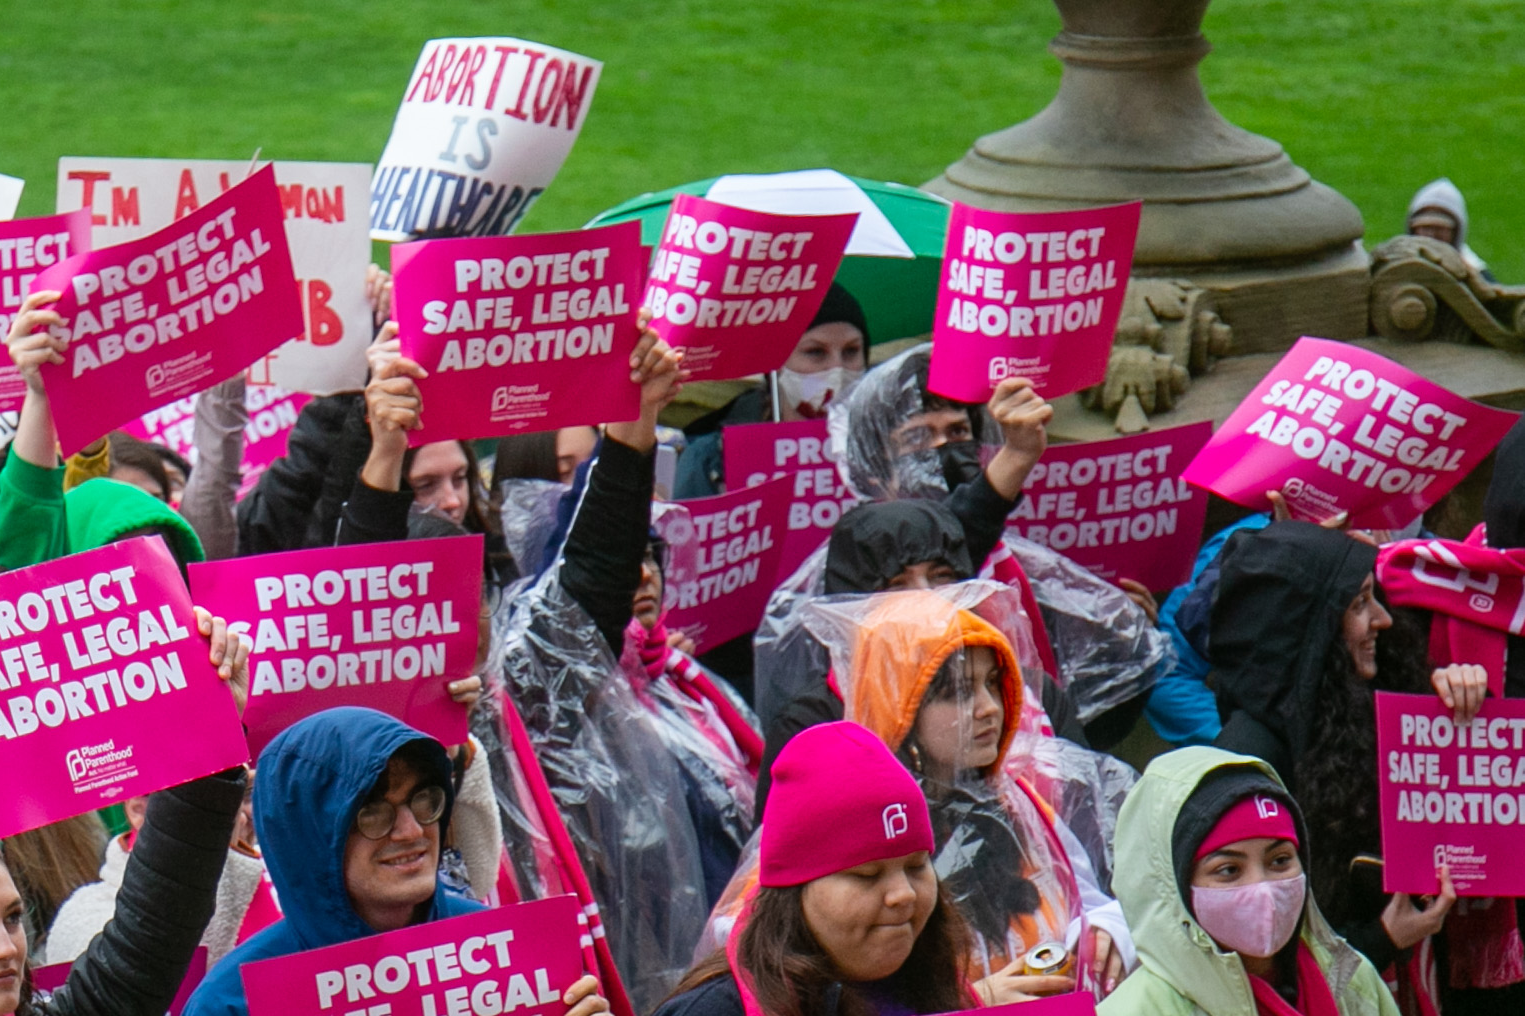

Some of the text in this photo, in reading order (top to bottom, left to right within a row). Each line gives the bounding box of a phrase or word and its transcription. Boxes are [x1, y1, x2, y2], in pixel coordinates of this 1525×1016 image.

[407, 44, 593, 131] ABORTION
[439, 115, 498, 171] IS
[174, 168, 199, 222] A
[72, 206, 236, 306] PROTECT
[665, 213, 814, 261] PROTECT
[961, 225, 1107, 265] PROTECT
[48, 290, 160, 344] SAFE,
[167, 227, 272, 307] LEGAL
[454, 247, 610, 293] PROTECT
[721, 263, 819, 297] LEGAL
[946, 259, 1118, 305] SAFE, LEGAL
[72, 265, 265, 380] ABORTION
[422, 283, 631, 335] SAFE, LEGAL
[946, 296, 1105, 339] ABORTION
[436, 322, 616, 374] ABORTION
[1303, 355, 1468, 442] PROTECT
[1261, 379, 1466, 473] SAFE, LEGAL
[1023, 444, 1174, 489] PROTECT
[1245, 410, 1436, 496] ABORTION
[1006, 477, 1194, 522] AFE, LEGAL
[697, 524, 774, 575] LEGAL
[254, 561, 434, 612] PROTECT
[61, 603, 190, 671] LEGAL
[225, 600, 461, 654] SAFE, LEGAL
[251, 641, 447, 697] ABORTION
[1401, 713, 1525, 750] PROTECT
[1388, 749, 1525, 790] SAFE, LEGA
[315, 929, 515, 1010] PROTECT
